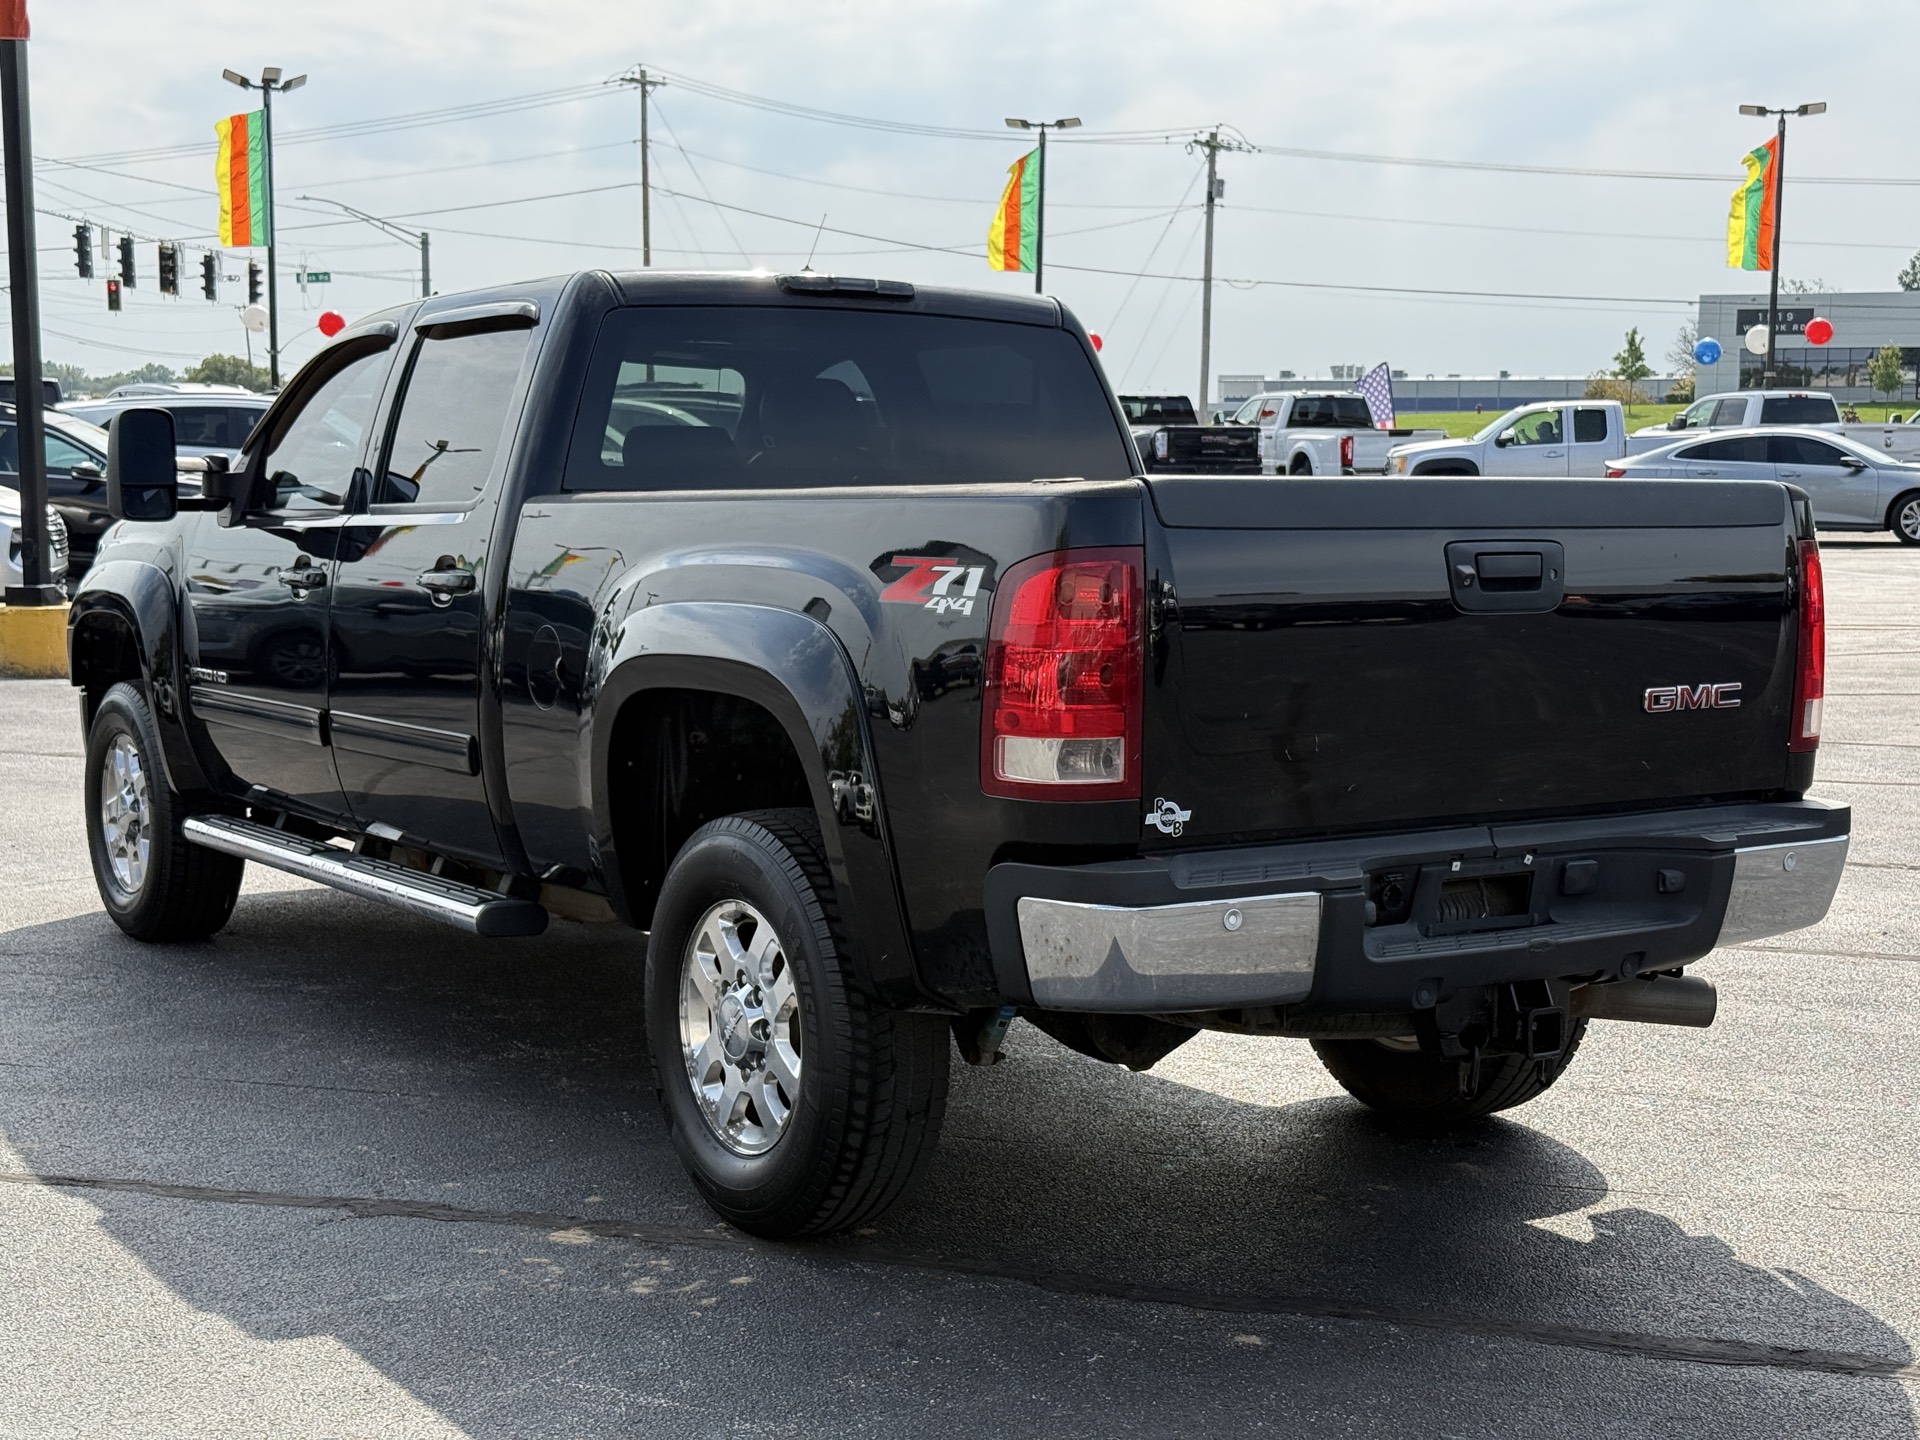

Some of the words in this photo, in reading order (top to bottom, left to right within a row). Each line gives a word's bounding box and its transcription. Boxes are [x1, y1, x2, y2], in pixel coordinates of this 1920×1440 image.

[1758, 312, 1794, 322] 119
[878, 555, 986, 605] Z71
[1644, 682, 1742, 714] GMC
